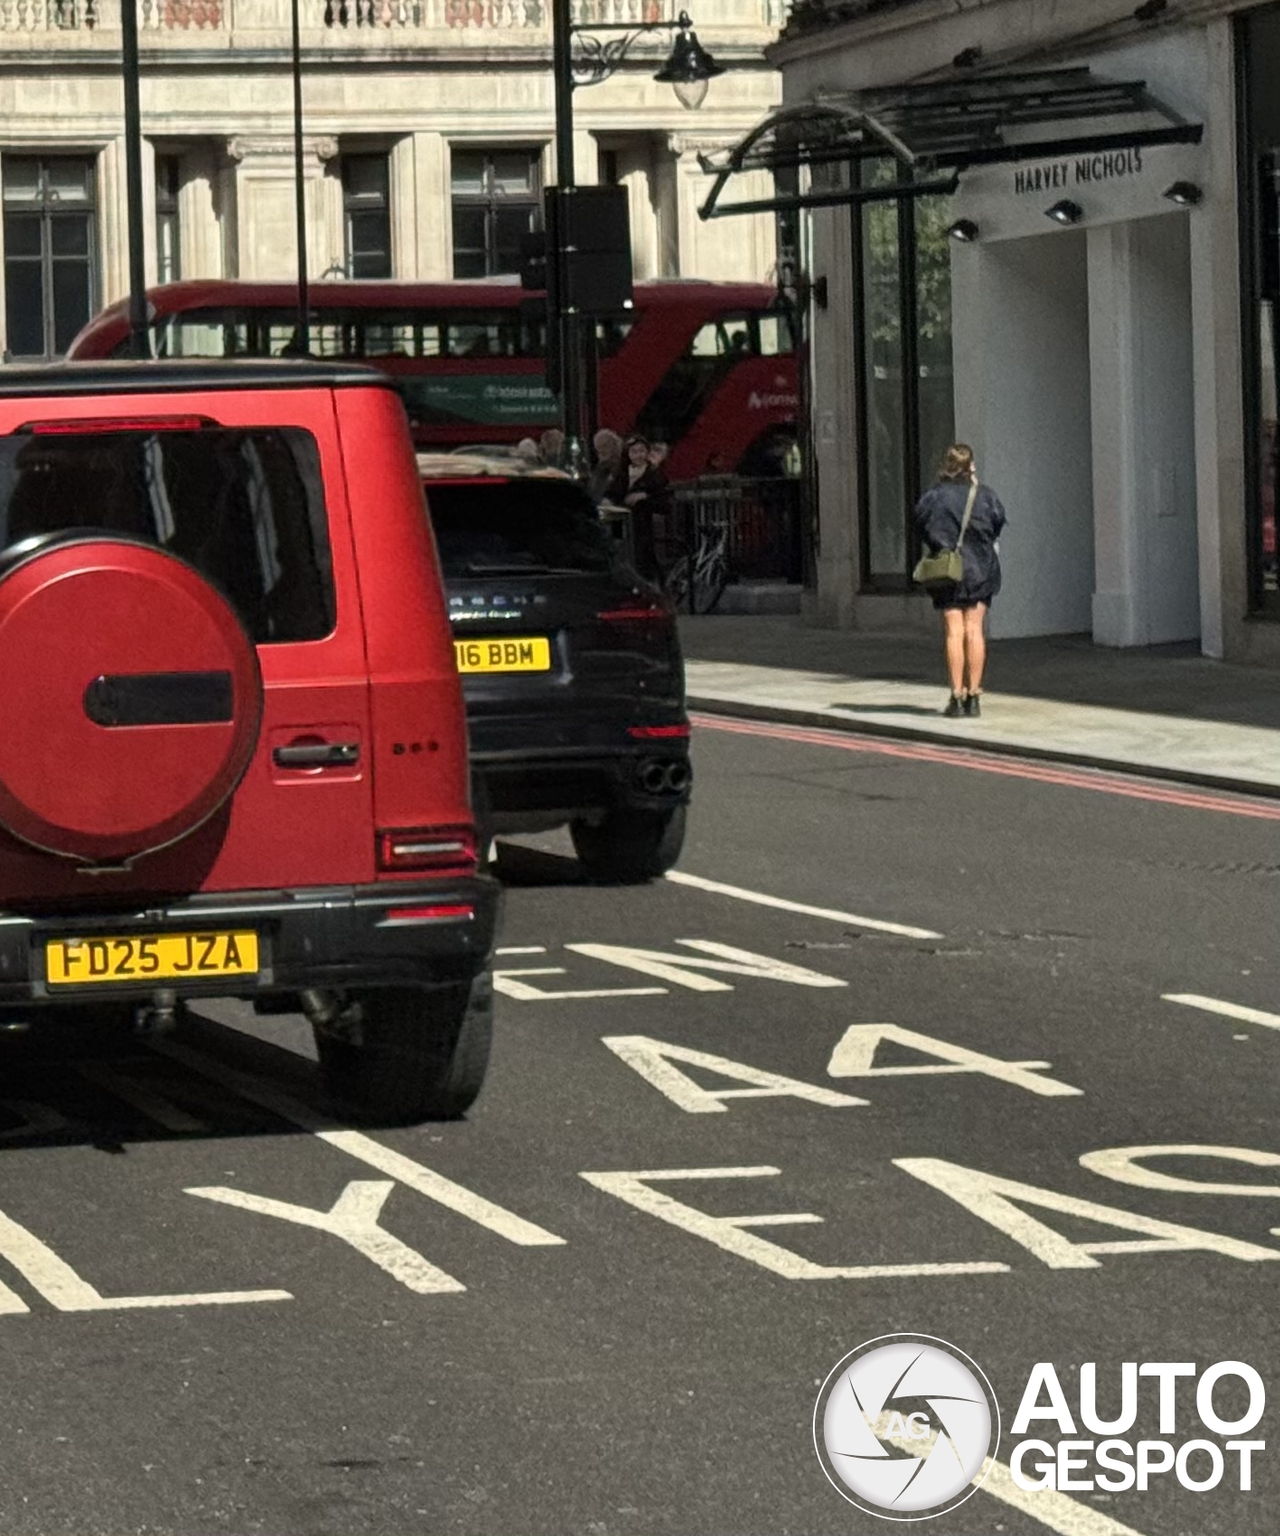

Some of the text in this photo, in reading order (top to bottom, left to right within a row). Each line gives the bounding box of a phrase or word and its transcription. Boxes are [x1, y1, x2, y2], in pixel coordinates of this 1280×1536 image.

[1014, 145, 1143, 194] HARVEY NICHOLS
[460, 643, 534, 666] 16 BBM
[63, 935, 243, 977] FD25 JZA
[492, 938, 849, 1000] EN
[600, 1023, 1084, 1114] A4
[578, 1143, 1280, 1280] EAS
